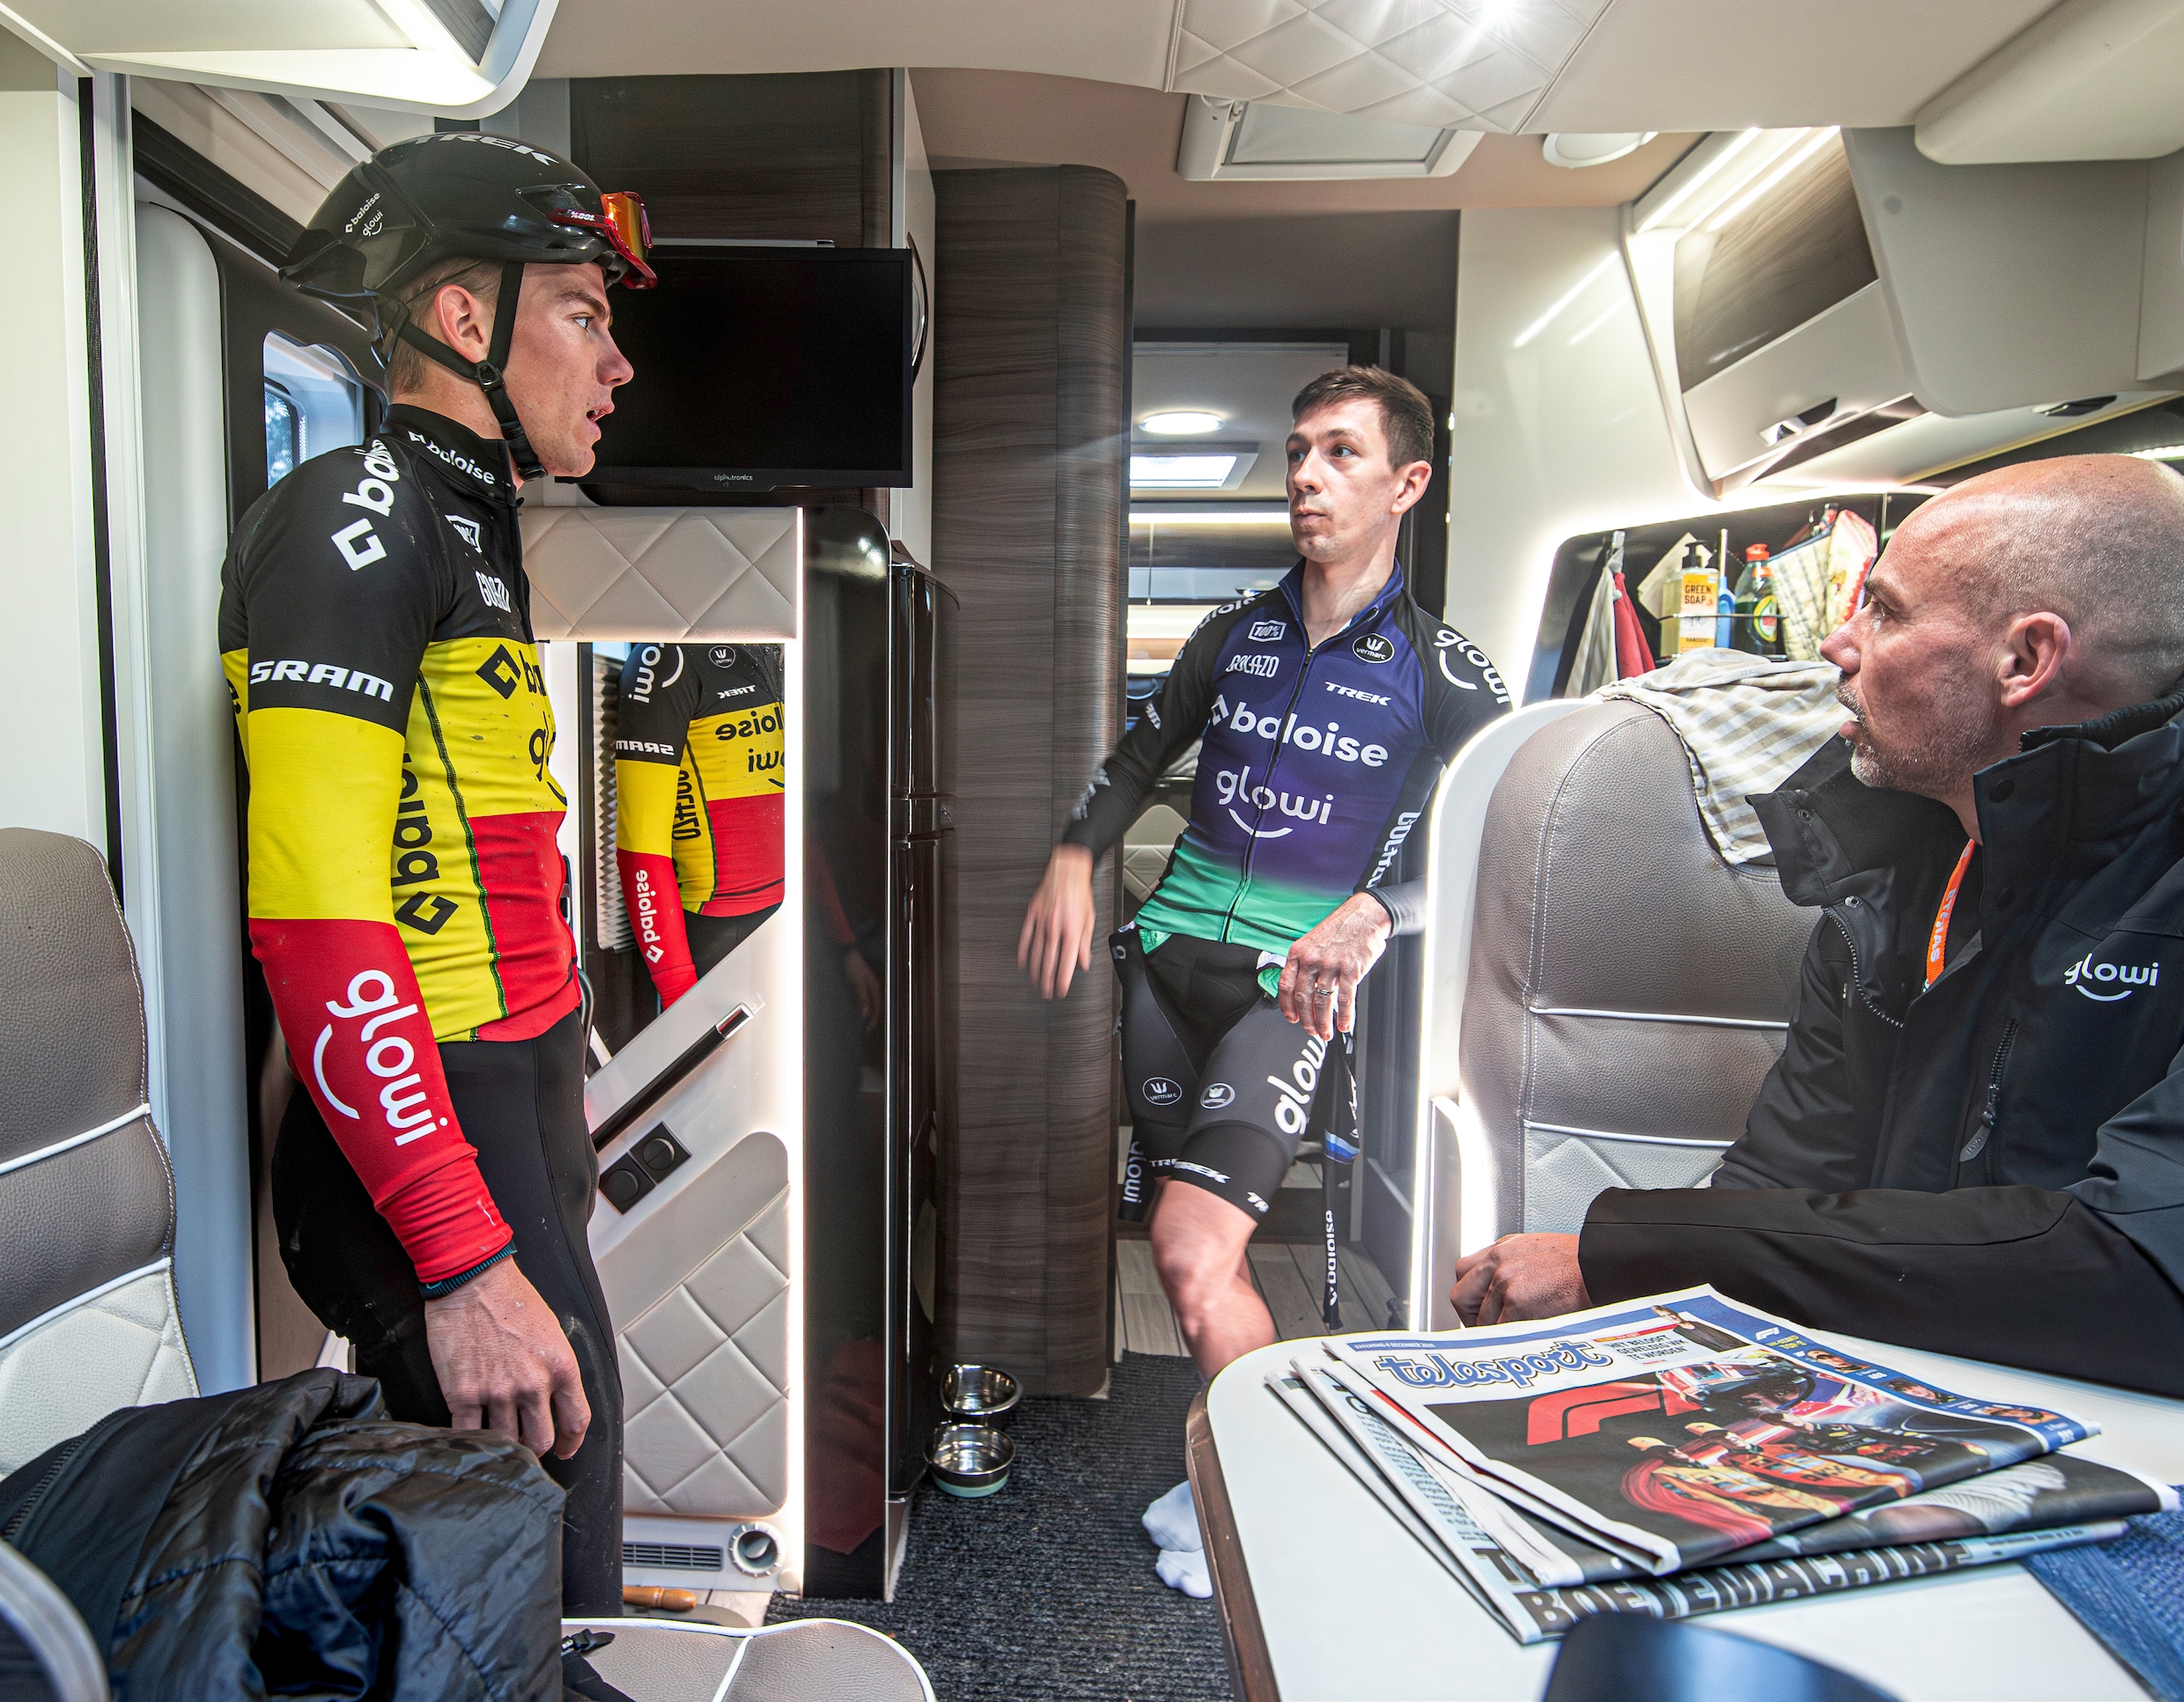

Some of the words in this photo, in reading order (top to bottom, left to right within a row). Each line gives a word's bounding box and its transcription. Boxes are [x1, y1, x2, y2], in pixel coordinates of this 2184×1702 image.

[415, 133, 559, 166] TREK
[350, 193, 380, 225] baloise
[362, 209, 384, 237] glowi
[1685, 585, 1712, 594] GREEN
[1685, 595, 1707, 605] SOAP
[1253, 625, 1280, 637] 100%
[1225, 654, 1280, 678] GOLAZO
[1356, 646, 1386, 660] vermarc
[249, 659, 395, 703] SRAM
[1324, 682, 1392, 706] TREK
[1229, 702, 1389, 768] baloise
[1216, 765, 1334, 825] glowi
[2063, 953, 2159, 986] glowi
[325, 969, 448, 1146] glowi
[1149, 1092, 1177, 1101] vermarc
[1266, 1035, 1328, 1135] glow
[1616, 1343, 1669, 1354] GEWELDIG
[1627, 1335, 1671, 1346] BELOOFT
[1373, 1339, 1613, 1389] telesport
